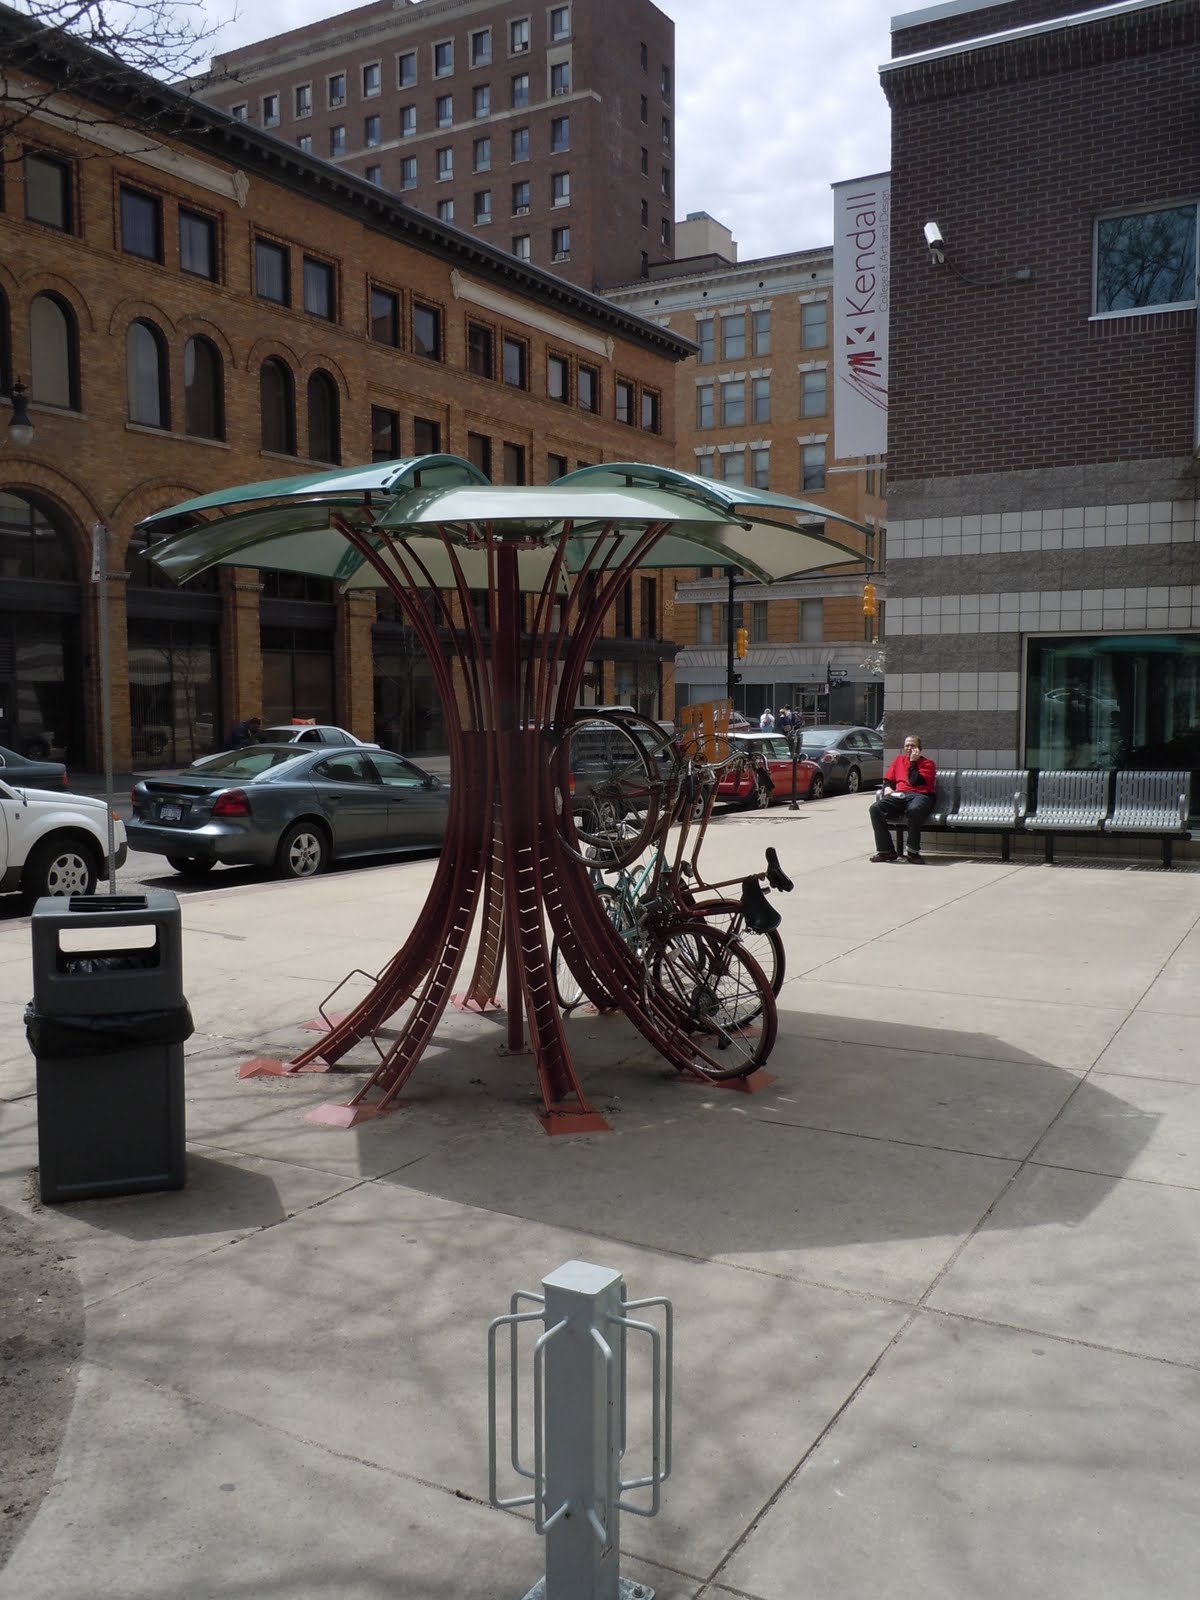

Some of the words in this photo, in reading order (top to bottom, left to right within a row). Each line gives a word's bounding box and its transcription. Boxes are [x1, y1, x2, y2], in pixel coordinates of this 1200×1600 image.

[879, 190, 890, 223] Design
[880, 224, 889, 242] and
[846, 192, 876, 317] Kendall
[880, 245, 889, 262] Art
[879, 264, 889, 274] of
[879, 276, 890, 312] College
